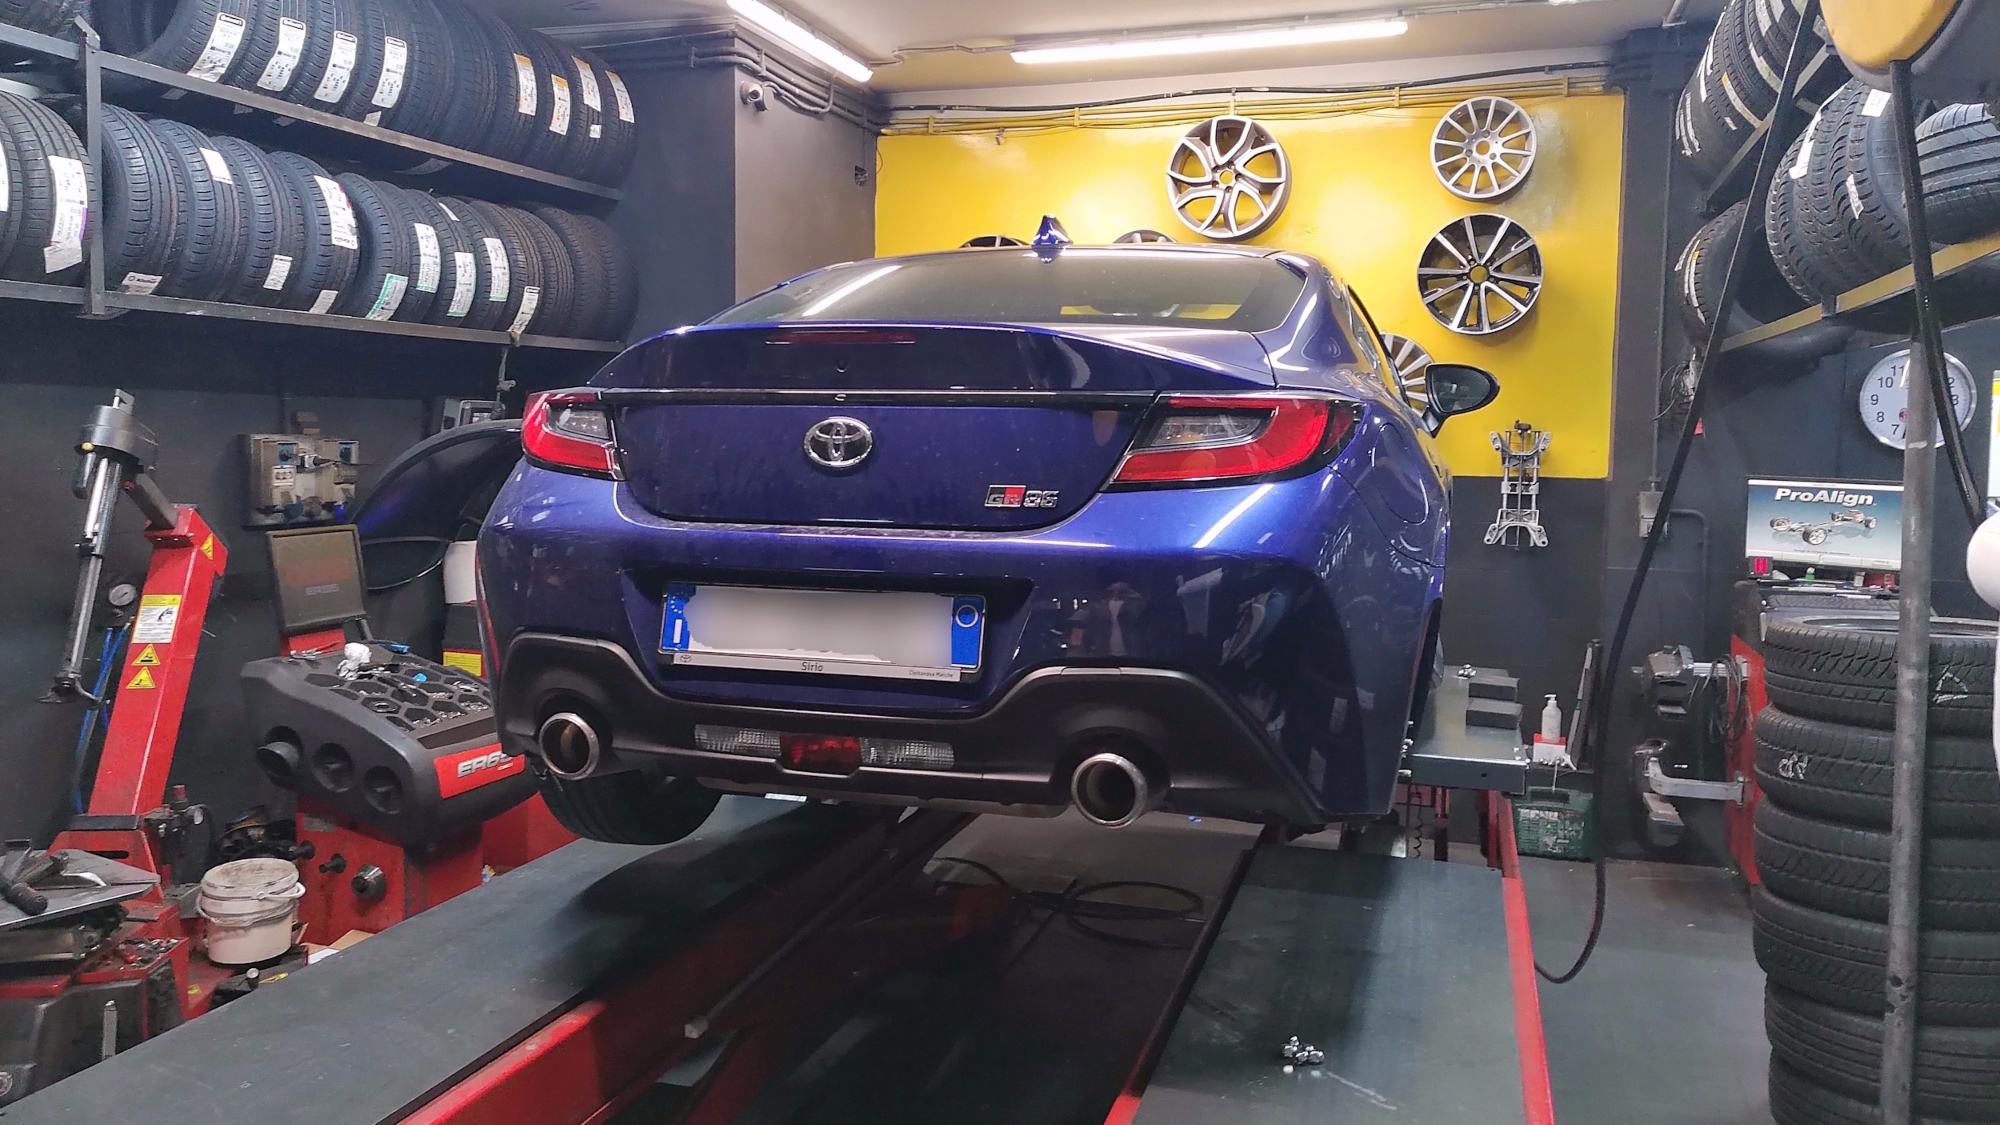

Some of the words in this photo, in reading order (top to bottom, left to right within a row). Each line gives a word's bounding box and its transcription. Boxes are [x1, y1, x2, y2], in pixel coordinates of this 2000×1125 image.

[1878, 377, 1894, 388] 10
[1870, 394, 1879, 405] 9
[1876, 411, 1885, 423] 8
[1891, 424, 1900, 435] 7
[1774, 488, 1874, 507] ProAlign
[801, 661, 824, 672] Sirio
